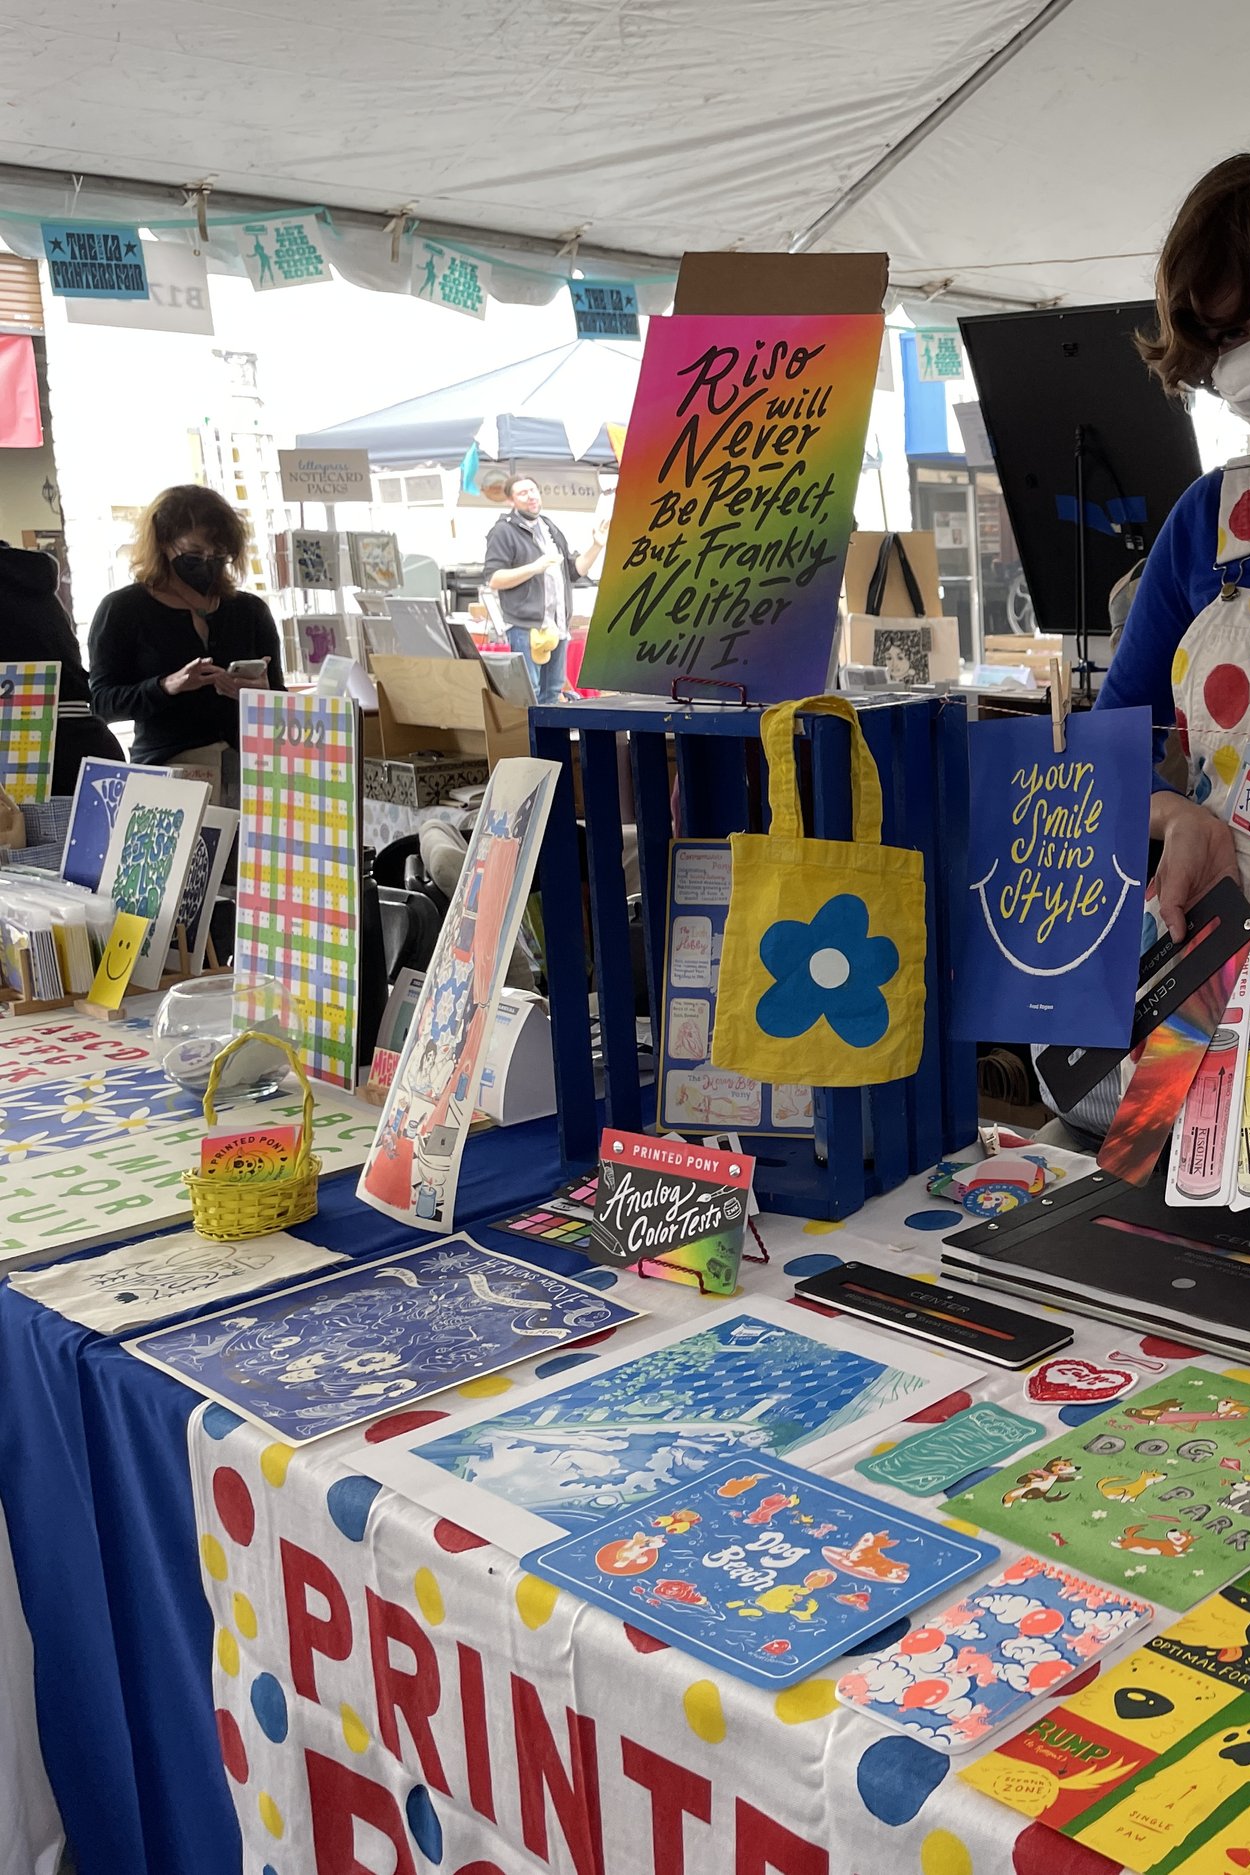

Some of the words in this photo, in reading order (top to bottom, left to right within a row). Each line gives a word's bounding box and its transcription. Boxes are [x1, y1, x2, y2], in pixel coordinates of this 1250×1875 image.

[66, 232, 98, 261] THE
[274, 224, 304, 238] LET
[275, 235, 309, 249] THE
[274, 245, 317, 260] GOOD
[51, 261, 116, 290] PRINTERS
[114, 263, 145, 291] FAIR
[677, 340, 826, 417] Riso
[766, 385, 833, 419] will
[658, 388, 820, 488] Never
[288, 471, 363, 485] NOTECARD
[306, 483, 349, 495] PACKS
[649, 490, 693, 532] Be
[698, 460, 836, 531] Perfect,
[622, 534, 686, 570] But
[693, 522, 837, 587] Frankly
[608, 559, 792, 637] Neither
[636, 632, 704, 674] will
[710, 630, 750, 670] I.
[273, 717, 326, 750] 2022
[1011, 762, 1095, 825] your
[1037, 841, 1055, 869] is
[1057, 841, 1095, 870] in
[1136, 977, 1177, 1022] CENTE
[1240, 978, 1248, 997] RED
[210, 1136, 255, 1166] PRINTED
[258, 1136, 286, 1154] PONY
[632, 1145, 683, 1166] PRINTED
[686, 1157, 720, 1173] PONY
[1193, 1127, 1207, 1175] RISOINK
[600, 1171, 697, 1230] Analog
[627, 1215, 676, 1252] Color
[674, 1204, 722, 1240] Tests
[459, 1258, 540, 1281] HEAVENS
[538, 1277, 589, 1309] ABOVE
[909, 1290, 970, 1314] CENTER
[1083, 1432, 1220, 1464] DOG
[744, 1530, 812, 1569] Dog
[702, 1546, 779, 1592] Beach
[1151, 1637, 1218, 1677] OPTIMAL
[1217, 1666, 1250, 1685] FOR
[1026, 1718, 1112, 1763] RUMP
[1003, 1783, 1046, 1796] ZONE
[1165, 1802, 1175, 1810] A
[1115, 1826, 1147, 1843] PAW
[1128, 1810, 1174, 1832] SINGLE
